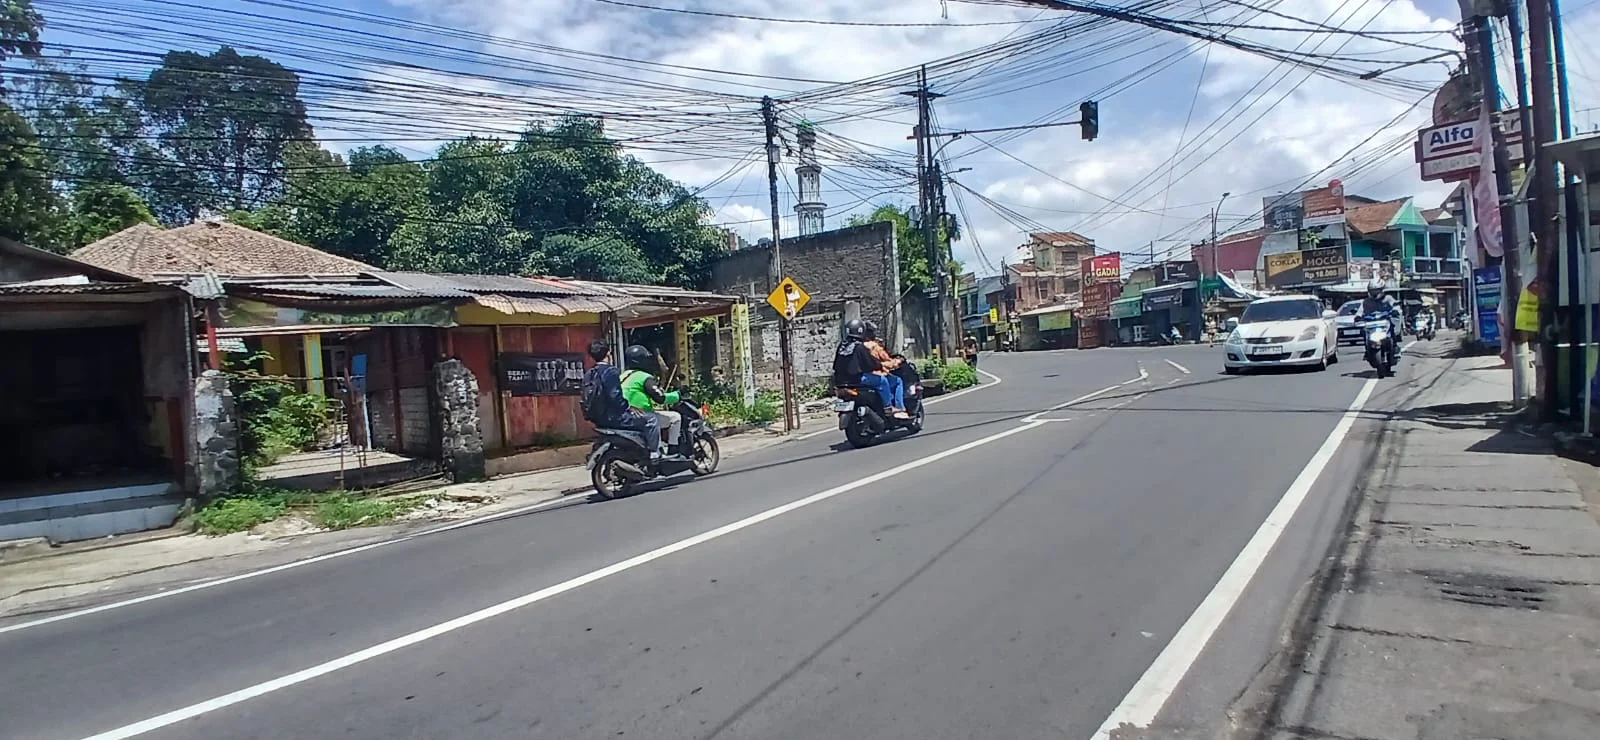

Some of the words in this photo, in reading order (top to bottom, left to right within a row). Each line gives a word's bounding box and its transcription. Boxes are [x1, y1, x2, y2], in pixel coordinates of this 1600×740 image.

[1271, 257, 1300, 267] COKLAT
[1306, 255, 1344, 267] MOCCA
[1095, 267, 1119, 277] GADAI
